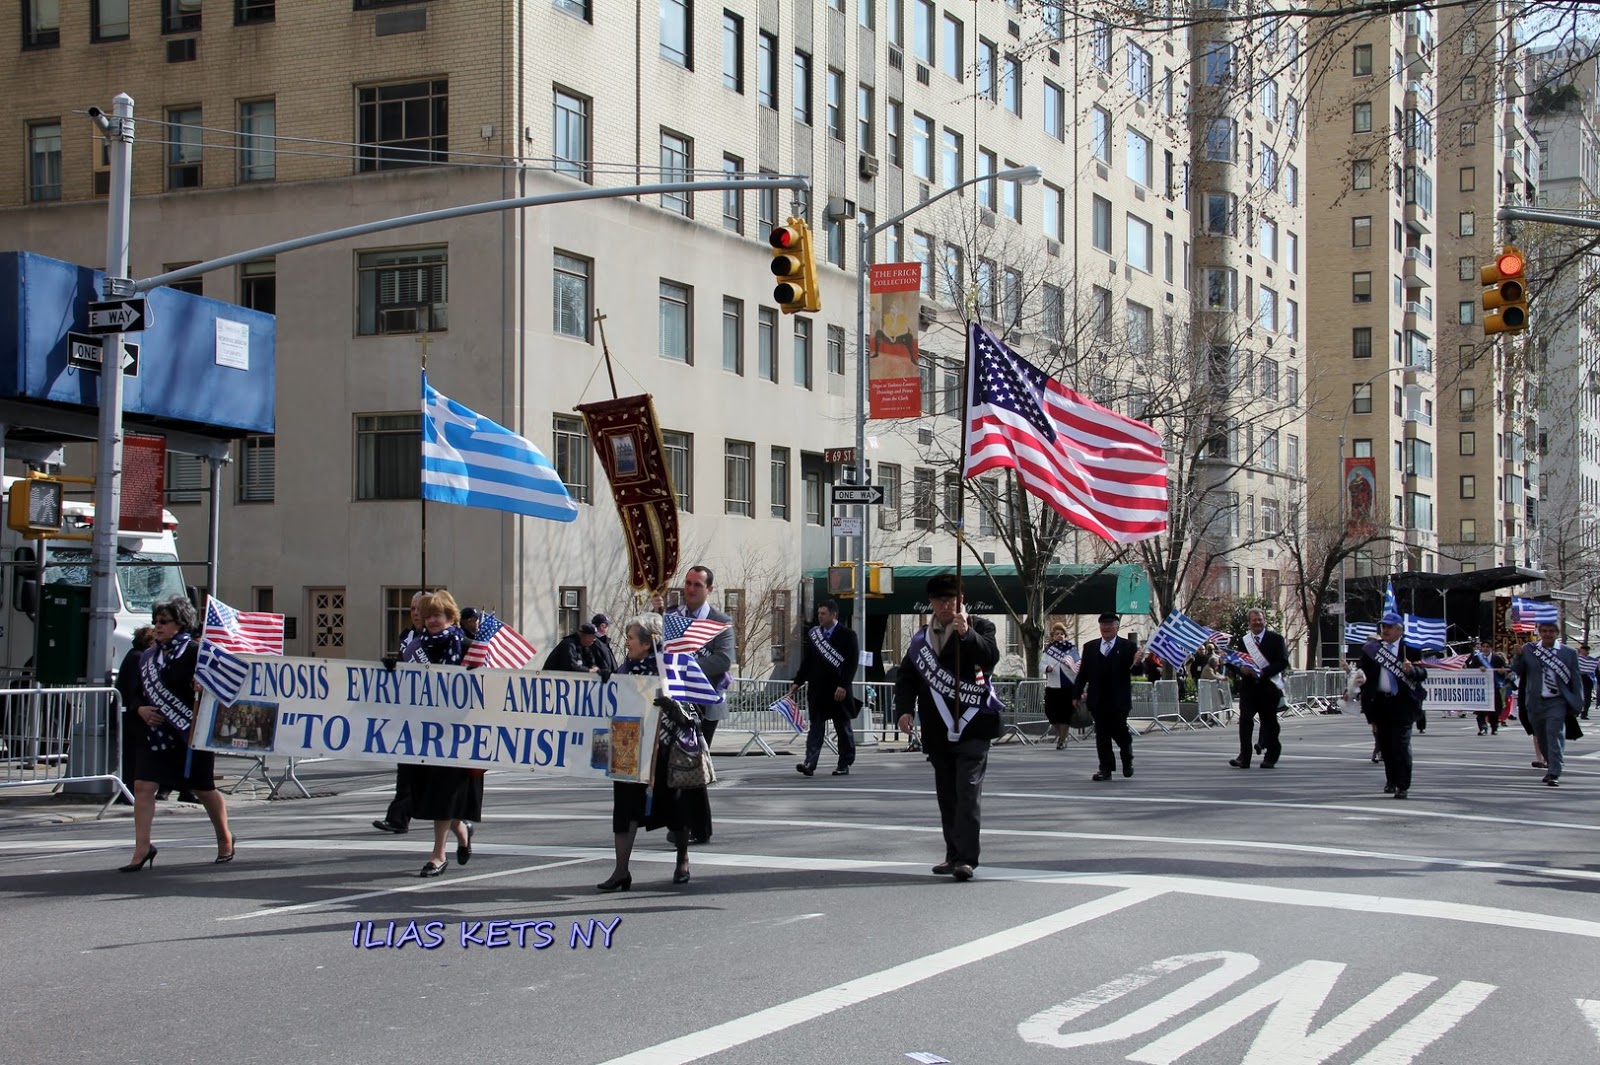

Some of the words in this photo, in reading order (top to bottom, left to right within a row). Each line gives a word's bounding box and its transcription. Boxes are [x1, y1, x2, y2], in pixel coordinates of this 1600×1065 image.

[874, 270, 892, 278] THE
[893, 269, 918, 278] FRICK
[873, 278, 918, 287] COLLECTION
[108, 310, 133, 324] WAY
[77, 345, 97, 360] ONE
[825, 451, 830, 463] E
[832, 450, 842, 462] 69
[843, 450, 852, 462] ST
[838, 491, 854, 499] ONE
[860, 491, 877, 499] WAY
[913, 601, 933, 613] Eigh
[919, 645, 937, 671] ENOSIS
[1374, 653, 1384, 664] TO
[915, 653, 925, 670] TO
[925, 670, 981, 706] KARPENISI
[1457, 677, 1486, 685] AMERIKIS
[250, 661, 329, 699] ENOSIS
[346, 666, 485, 711] EVRYTANON
[503, 676, 620, 719] AMERIKIS
[1434, 688, 1486, 702] PROUSSIOTISA
[143, 678, 191, 731] KARPENISI
[281, 712, 350, 751] "TO
[363, 717, 584, 769] KARPENISI"
